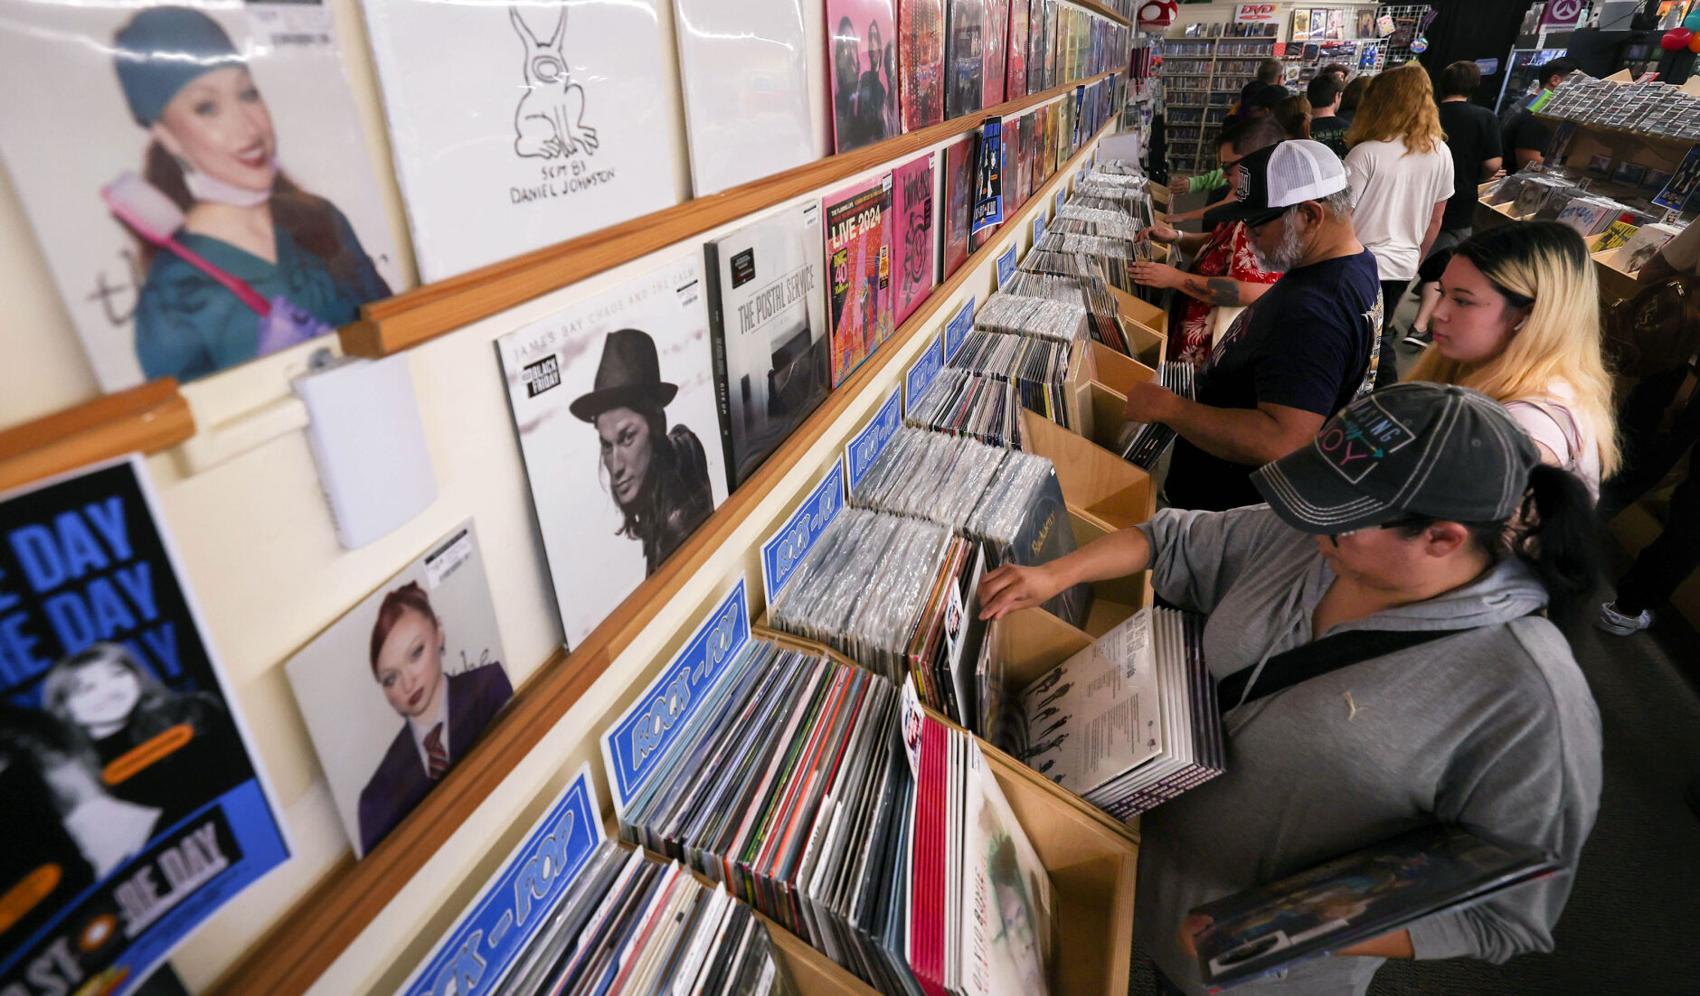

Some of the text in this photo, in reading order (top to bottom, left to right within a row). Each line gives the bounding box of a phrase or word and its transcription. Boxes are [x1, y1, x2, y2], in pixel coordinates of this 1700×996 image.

[1241, 4, 1273, 14] DVD
[510, 169, 616, 204] DANIEL JOHNSTON
[832, 204, 881, 249] LIVE 2024
[738, 300, 756, 335] THE
[756, 281, 786, 324] POSTAL
[787, 264, 815, 304] SERVICE
[530, 358, 559, 380] BLACK
[532, 370, 561, 394] FRIDAY
[1320, 428, 1368, 466] OY
[8, 496, 133, 593] DAY
